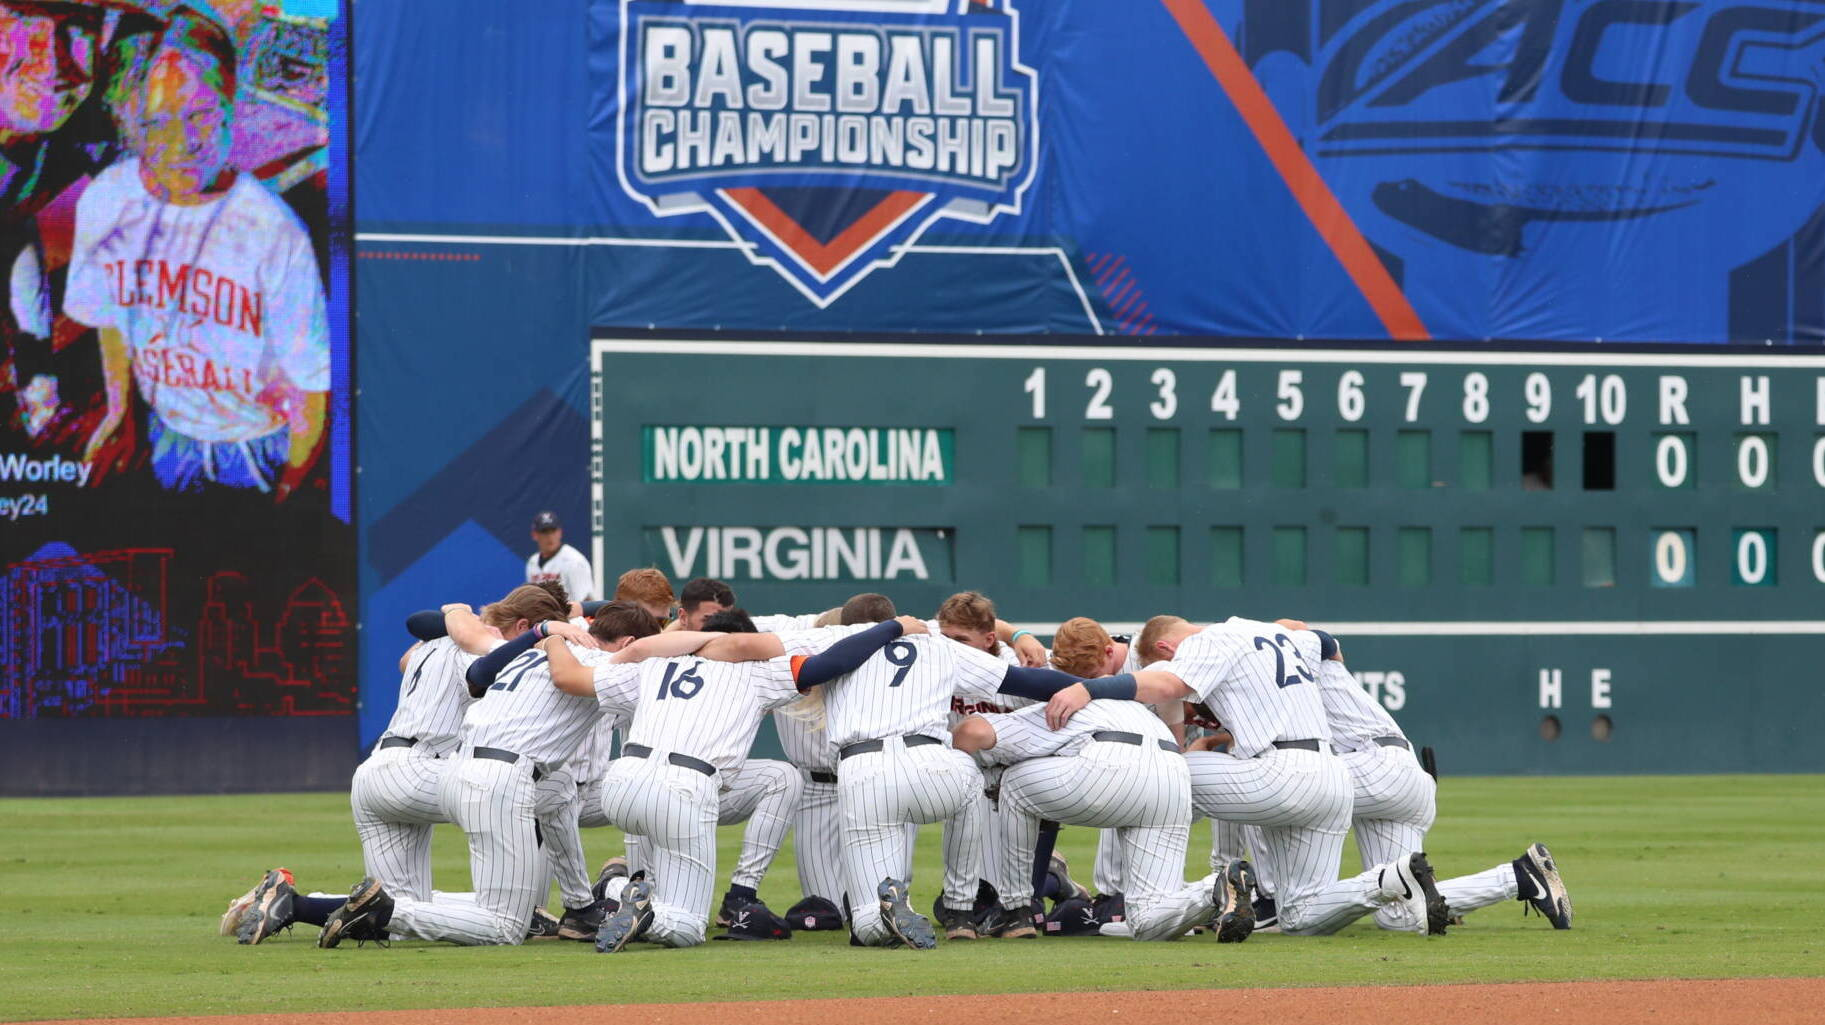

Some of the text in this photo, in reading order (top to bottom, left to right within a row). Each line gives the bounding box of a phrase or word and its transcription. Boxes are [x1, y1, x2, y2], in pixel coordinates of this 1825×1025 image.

[645, 26, 1015, 117] BASEBALL
[1364, 0, 1825, 117] ACC
[643, 109, 1017, 181] CHAMPIONSHIP
[1024, 367, 1046, 419] 1
[1085, 368, 1113, 420] 2
[1150, 367, 1178, 420] 3
[1211, 369, 1240, 421] 4
[1277, 370, 1304, 421] 5
[1338, 370, 1365, 422] 6
[1400, 372, 1427, 422] 7
[1463, 372, 1490, 423] 8
[1525, 372, 1552, 423] 9
[1576, 374, 1627, 425] 10
[1659, 375, 1690, 425] R
[1740, 375, 1770, 425] H
[0, 453, 93, 487] Worley
[654, 427, 770, 481] NORTH
[778, 427, 945, 481] CAROLINA
[1656, 435, 1687, 488] 0
[1738, 435, 1769, 488] 0
[662, 527, 929, 580] VIRGINIA
[1655, 532, 1687, 584] 0
[1738, 531, 1767, 584] 0
[656, 660, 704, 700] 16
[883, 641, 918, 687] 9
[1254, 633, 1315, 689] 23
[1539, 668, 1612, 709] H E
